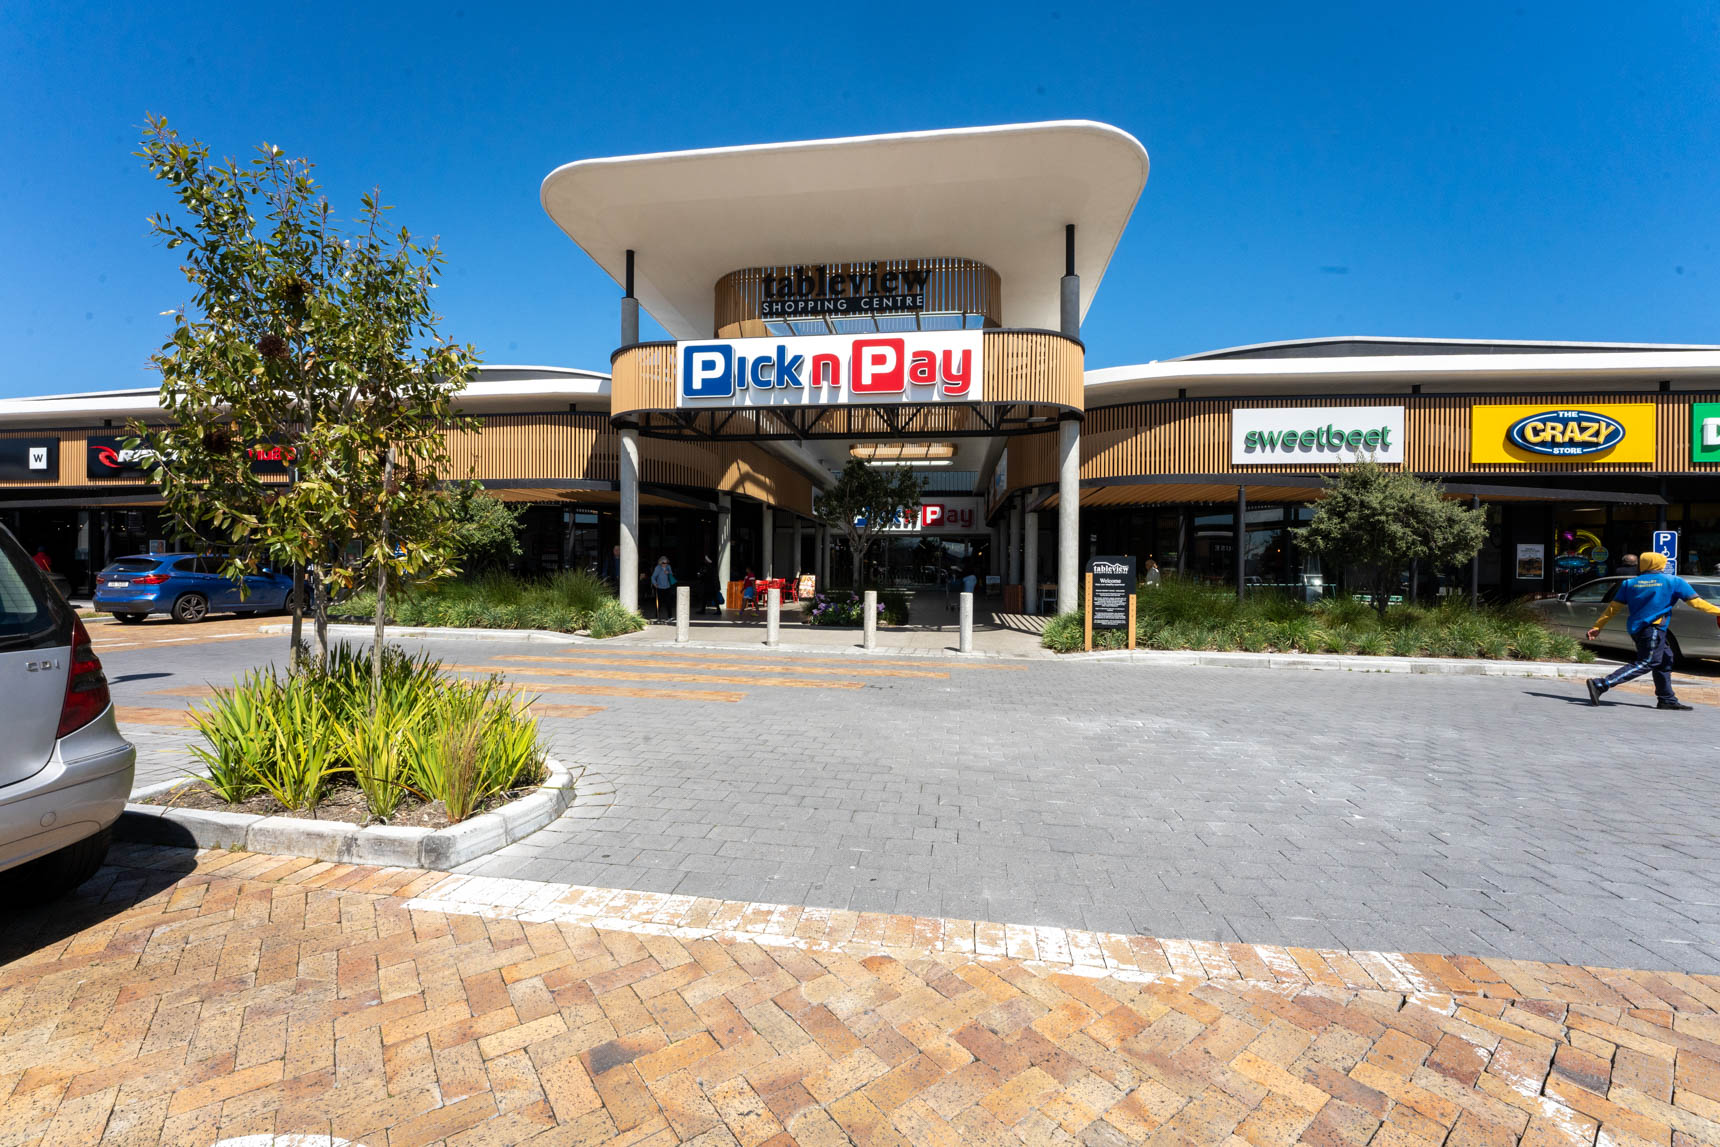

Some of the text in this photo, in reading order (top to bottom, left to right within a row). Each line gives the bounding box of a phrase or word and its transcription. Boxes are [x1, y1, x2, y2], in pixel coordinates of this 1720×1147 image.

[762, 263, 931, 299] tableview
[762, 295, 924, 313] SHOPPING CENTRE
[684, 338, 972, 397] Pick n Pay
[1245, 424, 1393, 448] sweetbeet
[1523, 420, 1616, 445] CRAZY
[33, 453, 44, 463] W
[1552, 447, 1583, 455] STORE
[922, 504, 973, 528] Pay
[1659, 533, 1672, 546] P
